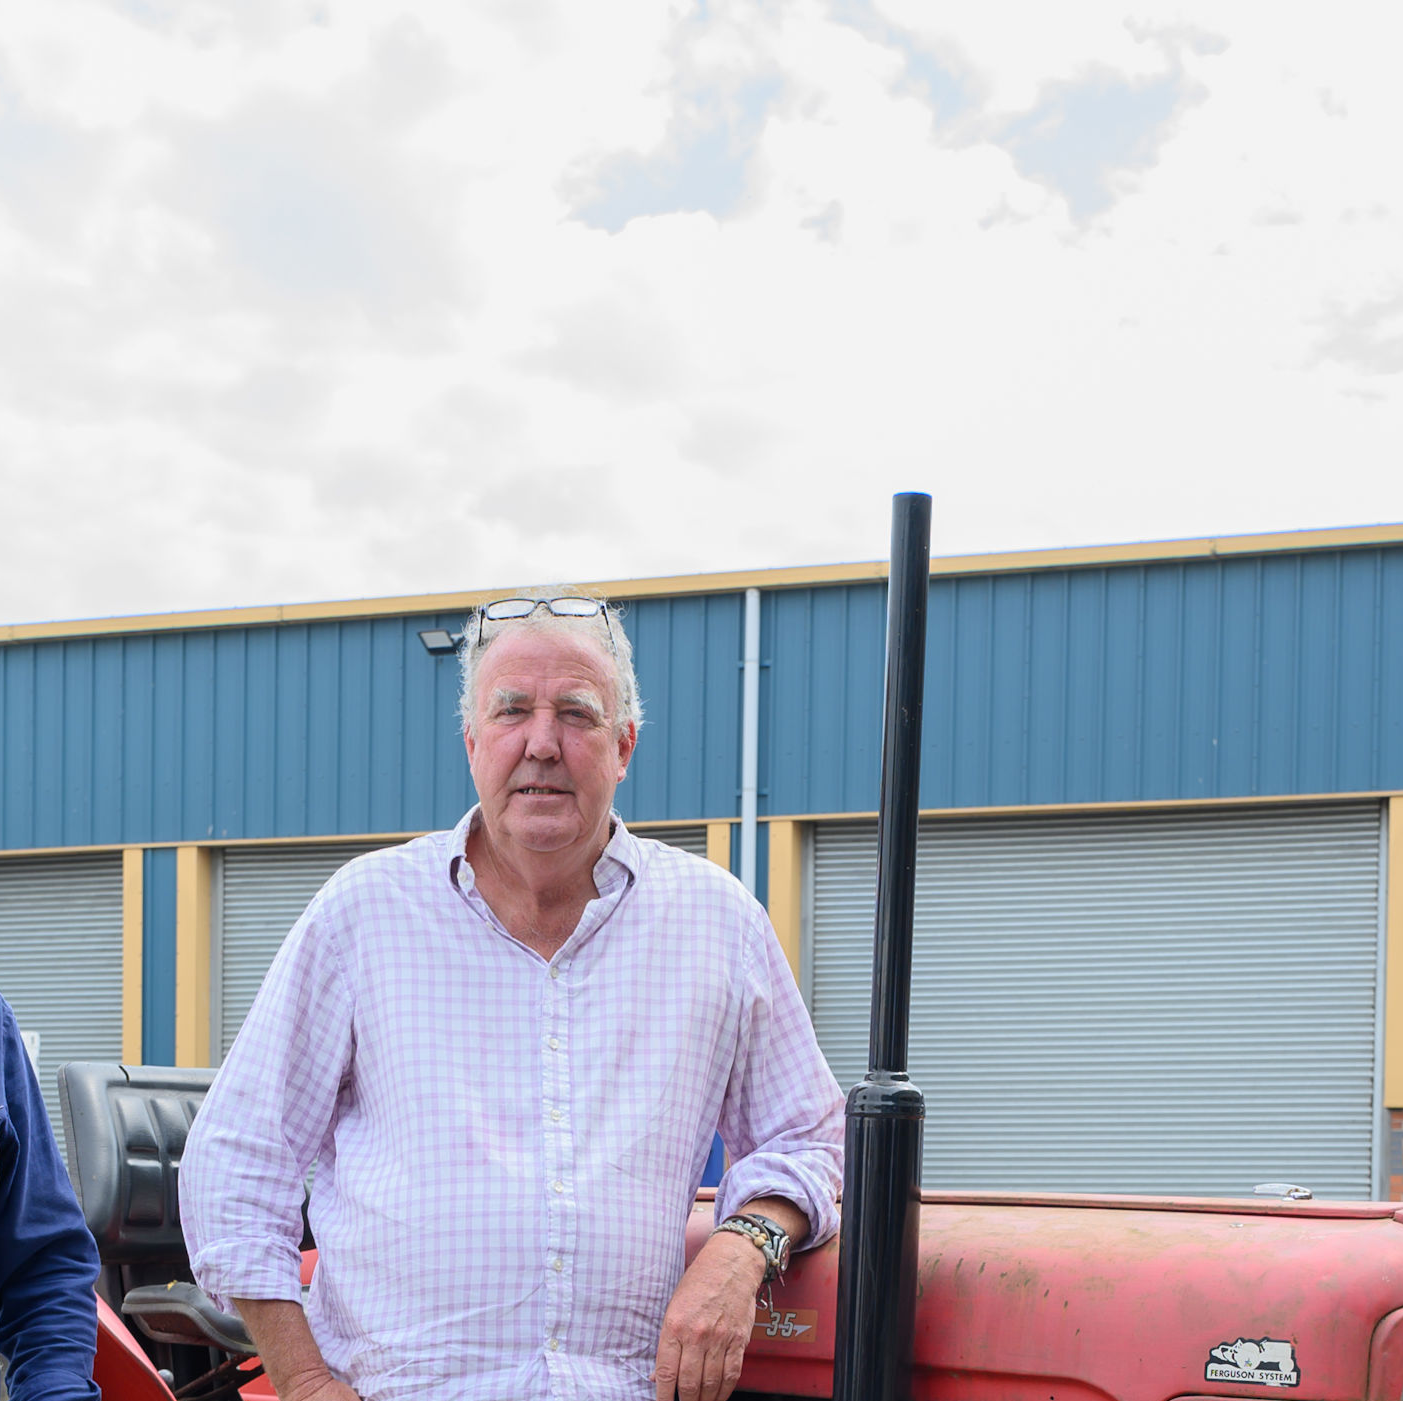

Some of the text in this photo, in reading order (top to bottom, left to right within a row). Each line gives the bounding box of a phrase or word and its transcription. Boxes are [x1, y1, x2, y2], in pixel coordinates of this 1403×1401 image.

[766, 1311, 796, 1337] 35
[1210, 1369, 1292, 1381] FERGUSON SYSTEM
